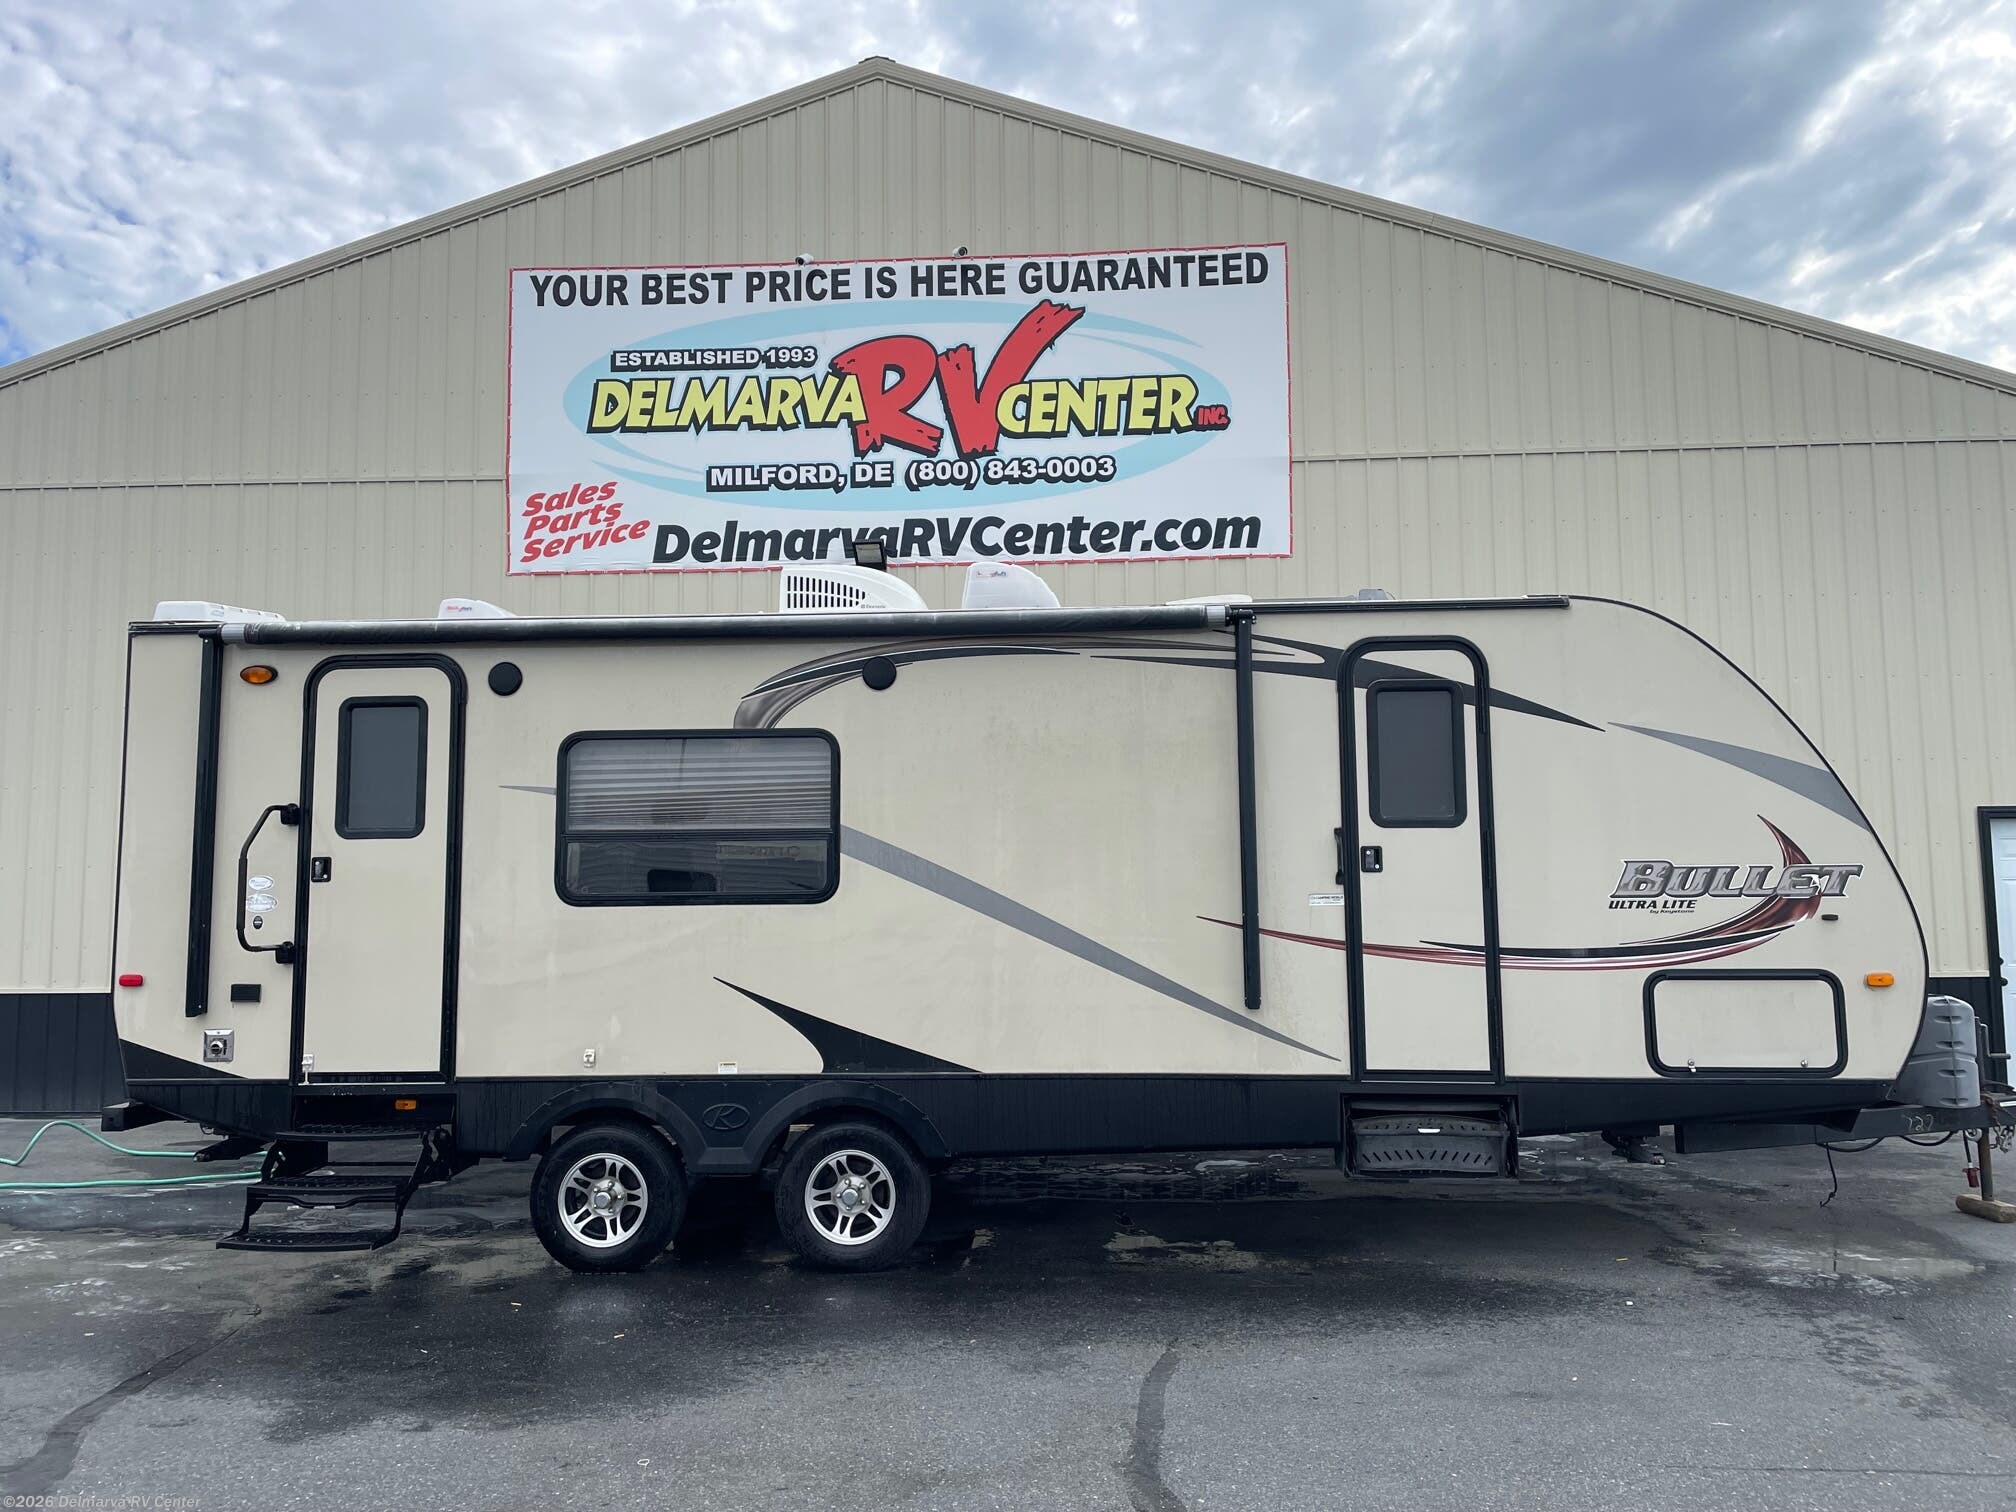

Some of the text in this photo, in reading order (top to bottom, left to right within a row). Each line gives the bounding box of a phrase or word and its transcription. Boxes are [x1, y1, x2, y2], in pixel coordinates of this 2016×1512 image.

[530, 252, 1270, 307] YOUR BEST PRICE IS HERE GUARANTEED
[613, 347, 817, 368] ESTABLISHED 1993
[589, 373, 869, 432] DELMARVA
[829, 299, 1086, 458] RV
[996, 374, 1199, 436] CENTER
[710, 456, 1117, 490] MILFORD, DE (800) 843-0003
[521, 481, 618, 517] Sales
[523, 501, 624, 540] Parts
[652, 515, 1262, 562] DelmarvaRVCenter.com
[520, 518, 651, 563] Service
[1608, 899, 1698, 910] ULTRA LITE
